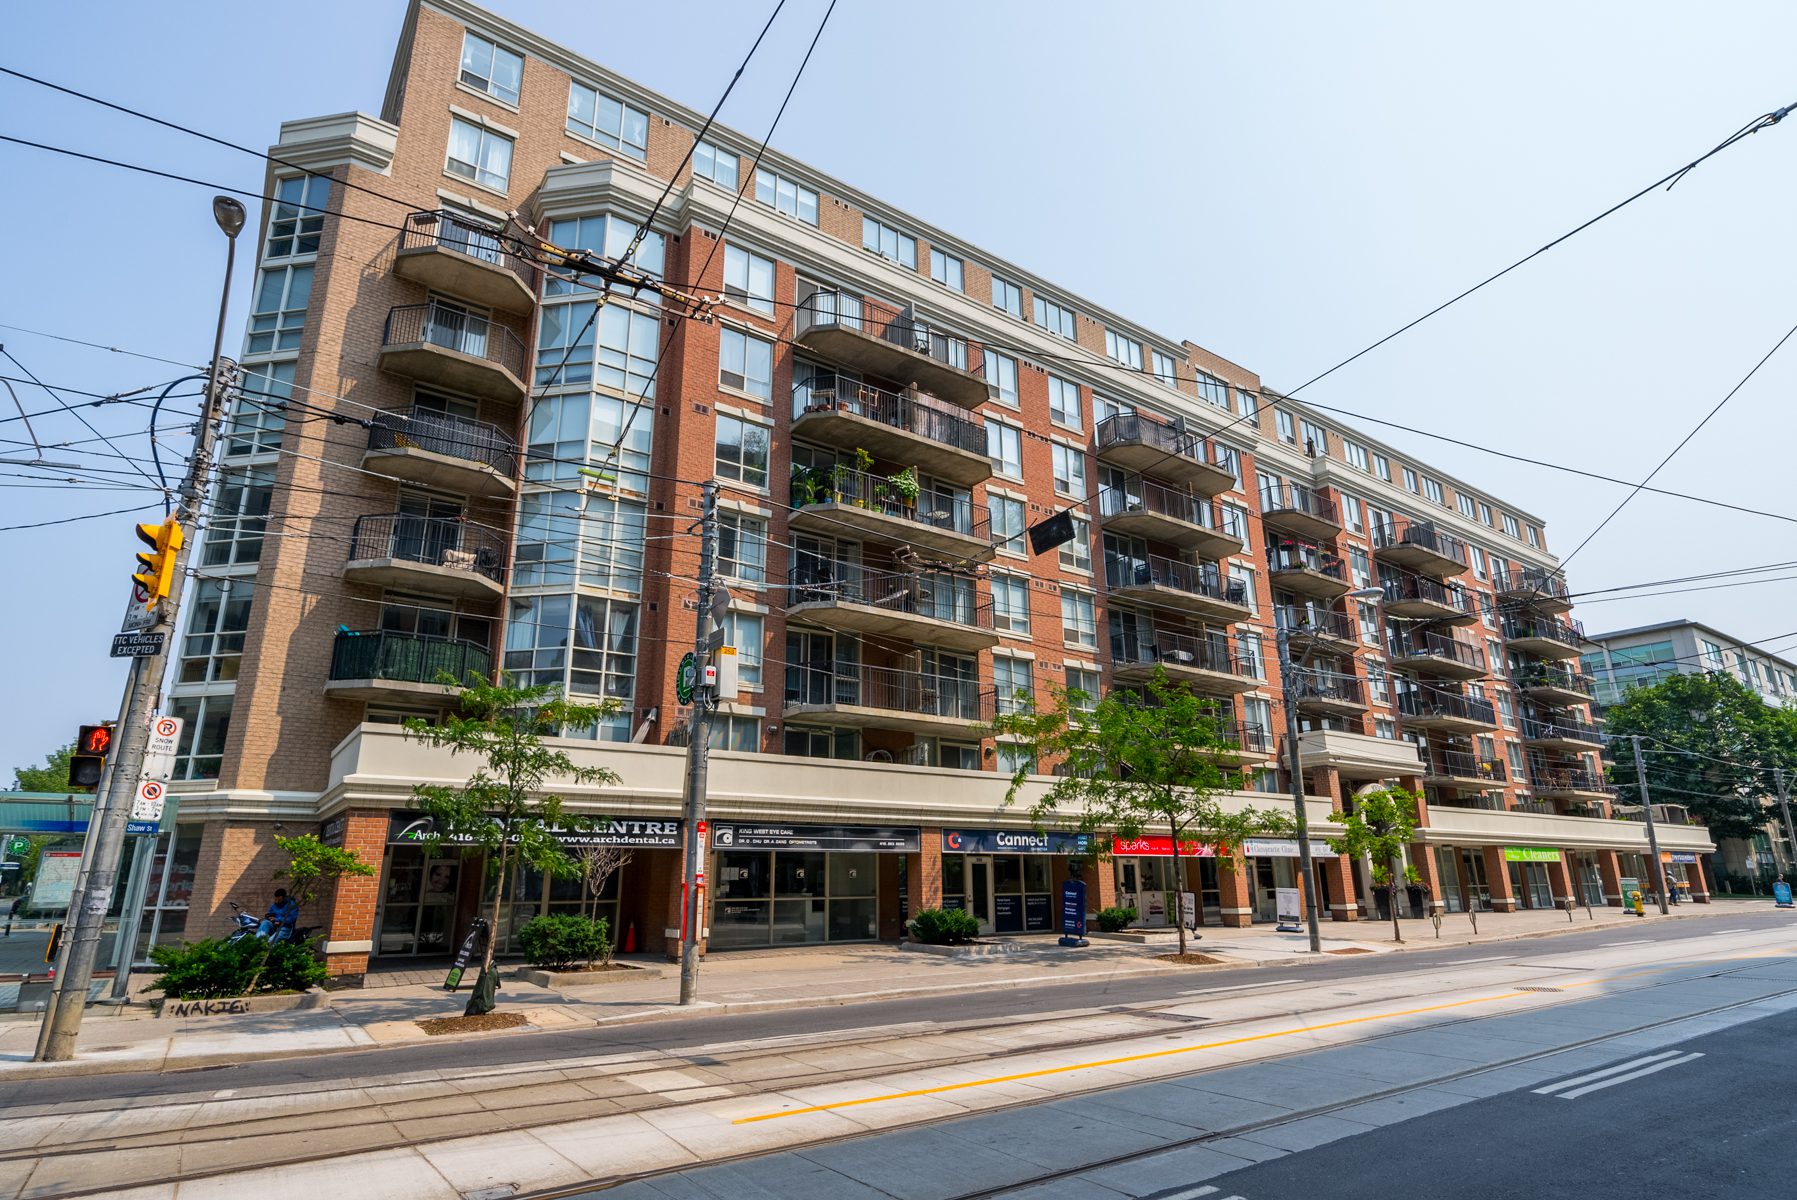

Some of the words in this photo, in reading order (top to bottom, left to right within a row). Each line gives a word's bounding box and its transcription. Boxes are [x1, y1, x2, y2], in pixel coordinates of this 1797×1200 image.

[114, 636, 128, 645] TTC
[129, 634, 164, 644] VEHICLES
[117, 645, 155, 655] EXCEPTED
[152, 743, 173, 752] ROUTE
[127, 823, 146, 832] Shaw
[413, 830, 440, 840] Arch
[996, 831, 1049, 847] Cannect
[556, 836, 676, 845] www.archdental.ca
[1120, 839, 1150, 852] sparks
[1523, 847, 1560, 861] Cleaners
